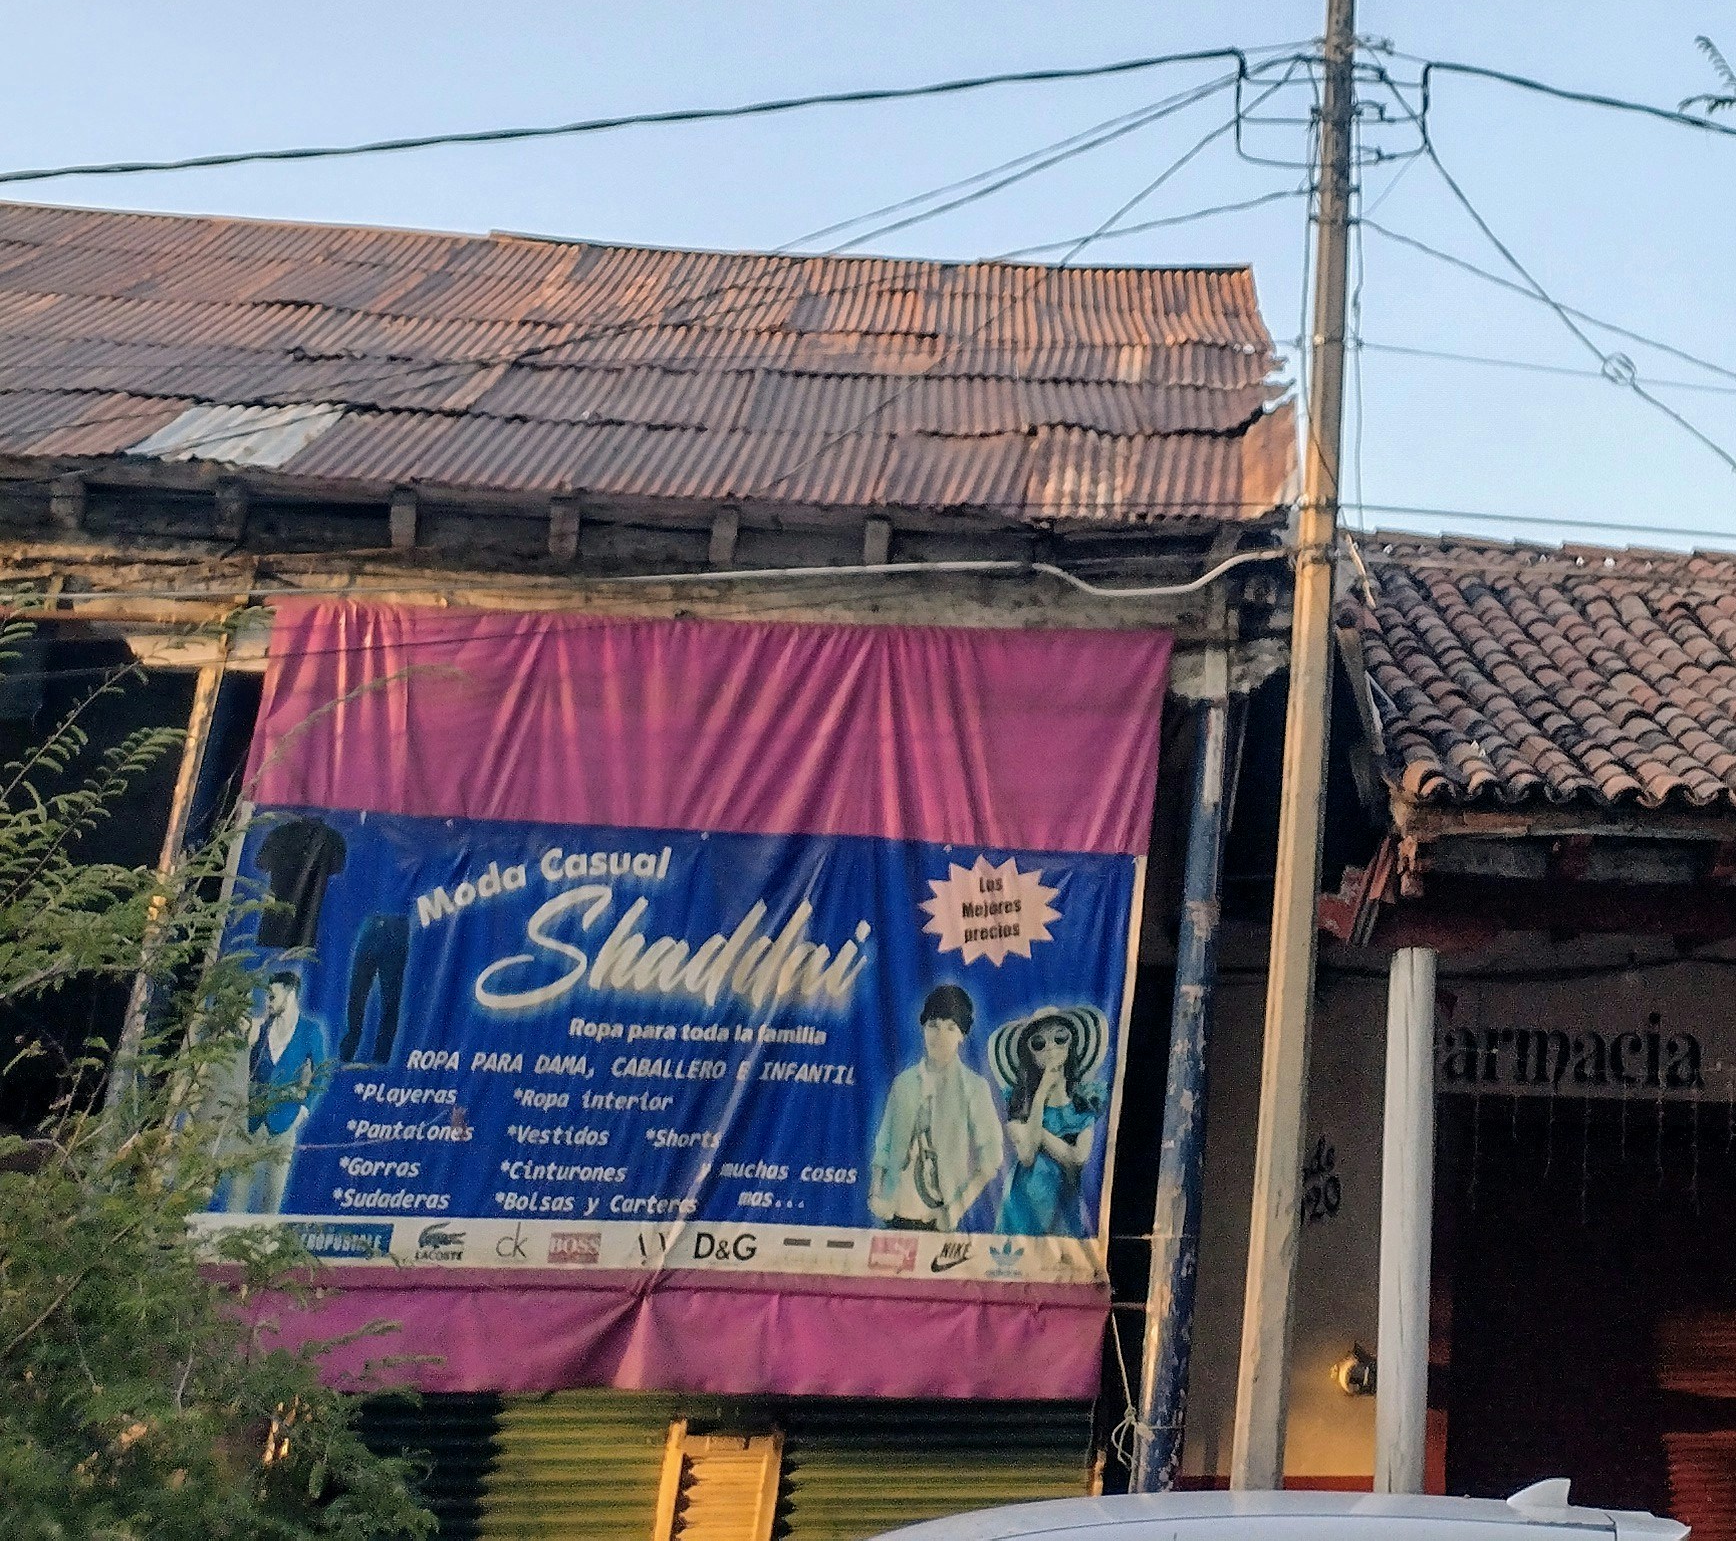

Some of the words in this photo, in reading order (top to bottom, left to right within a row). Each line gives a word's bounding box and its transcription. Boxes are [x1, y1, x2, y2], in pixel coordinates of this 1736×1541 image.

[415, 860, 527, 927] Moda
[540, 846, 672, 881] Casual
[979, 876, 1003, 893] Los
[474, 883, 872, 1009] Shaddai
[569, 1017, 624, 1043] Ropa
[627, 1024, 677, 1043] para
[680, 1023, 729, 1043] toda
[734, 1024, 754, 1043] la
[757, 1023, 827, 1046] familia
[1434, 989, 1704, 1089] armacia
[407, 1049, 460, 1071] ROPA
[470, 1051, 524, 1073] PARA
[533, 1054, 596, 1079] DAMA,
[610, 1055, 727, 1081] CABALLERO
[758, 1061, 856, 1086] INFANTIL
[581, 1088, 674, 1112] interior
[720, 1160, 789, 1180] muchas
[800, 1166, 858, 1185] cosas
[583, 1196, 600, 1216] y
[693, 1231, 758, 1261] D&G
[939, 1240, 974, 1260] NIKE
